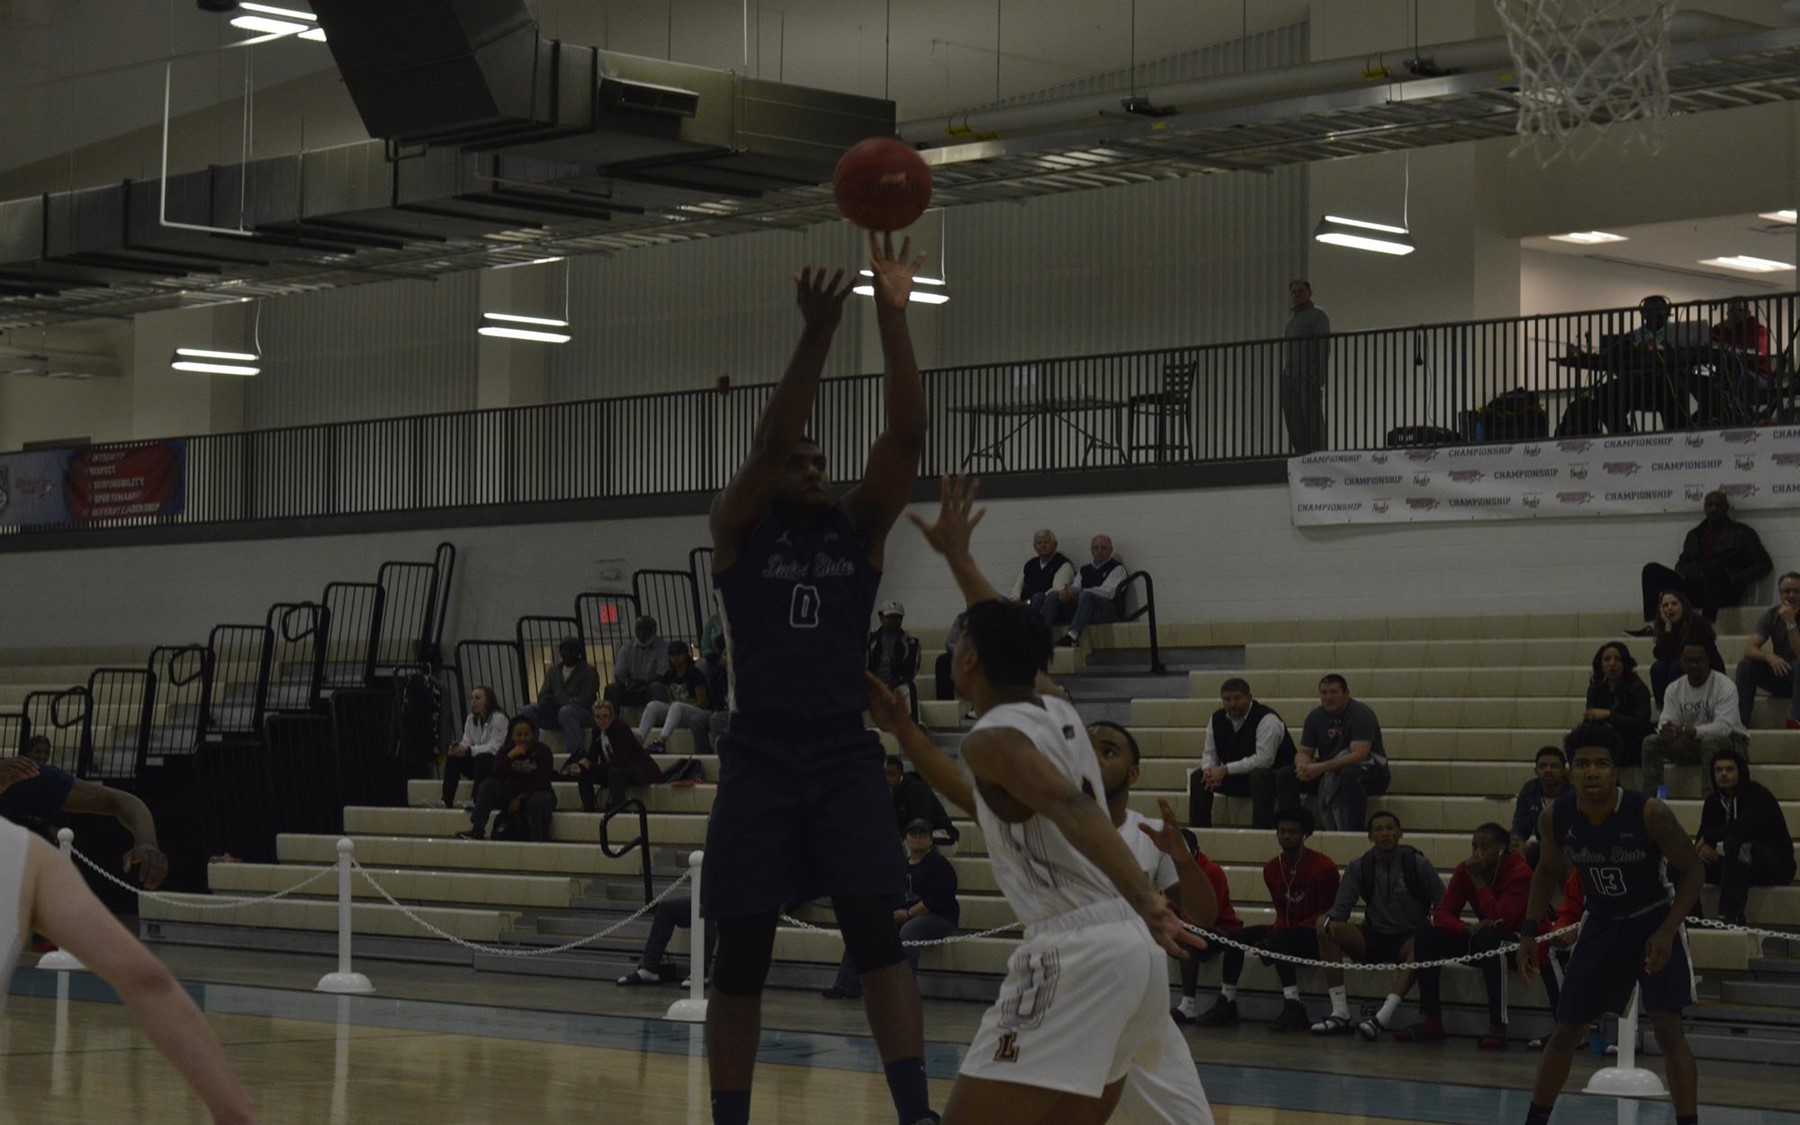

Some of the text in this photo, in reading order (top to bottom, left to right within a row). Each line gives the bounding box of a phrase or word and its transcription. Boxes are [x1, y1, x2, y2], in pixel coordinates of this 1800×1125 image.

[1604, 437, 1673, 449] CHAMPIONSHIP
[1448, 446, 1513, 458] CHAMPIONSHIP
[1301, 454, 1362, 464] CHAMPIONSHIP
[1651, 459, 1723, 472] CHAMPIONSHIP
[1493, 468, 1559, 480] CHAMPIONSHIP
[1344, 475, 1403, 486] CHAMPIONSHIP
[1605, 489, 1673, 501] CHAMPIONSHIP
[1297, 503, 1362, 512] CHAMPIONSHIP
[1448, 497, 1511, 508] CHAMPIONSHIP
[790, 583, 820, 628] 0
[1589, 867, 1627, 896] 13
[993, 1030, 1020, 1063] L
